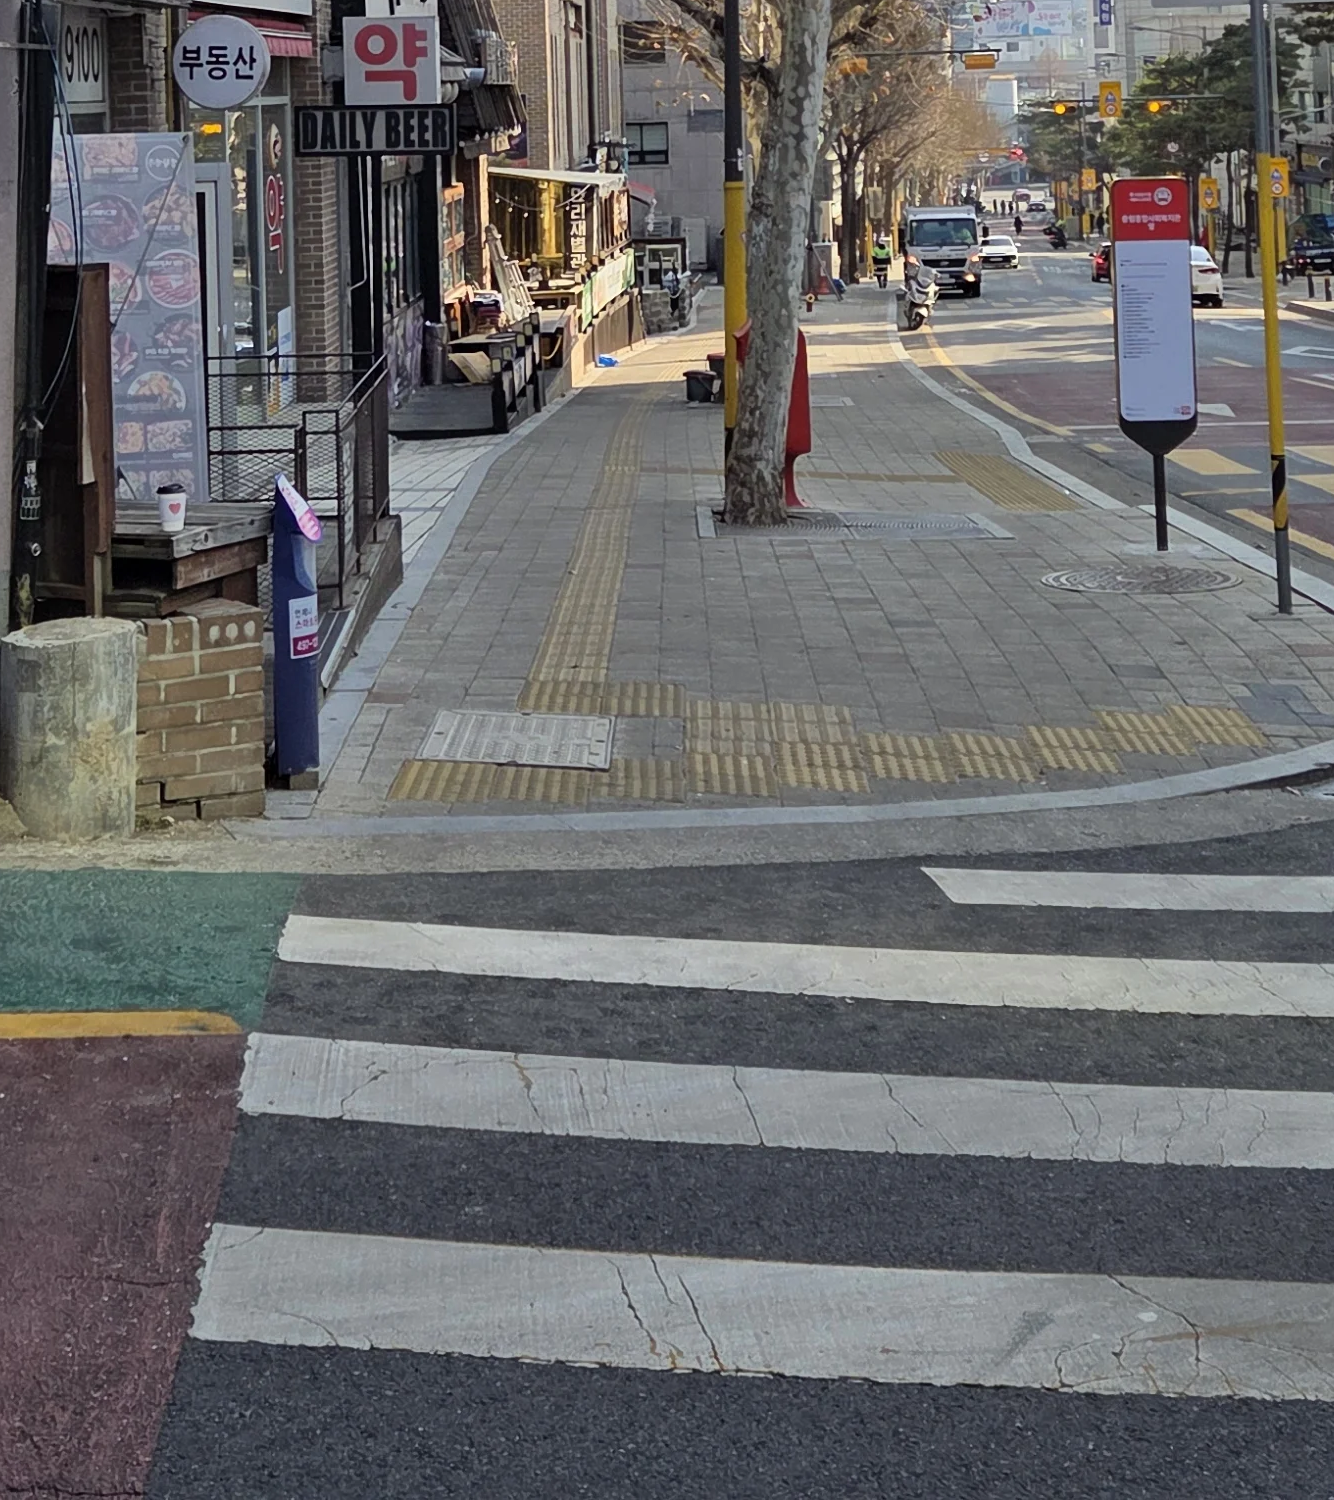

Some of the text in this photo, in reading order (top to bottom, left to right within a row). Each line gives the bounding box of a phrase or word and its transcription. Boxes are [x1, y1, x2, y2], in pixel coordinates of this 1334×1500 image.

[179, 46, 257, 81] 부동산
[354, 23, 428, 101] 약
[301, 110, 448, 150] DAILY BEER
